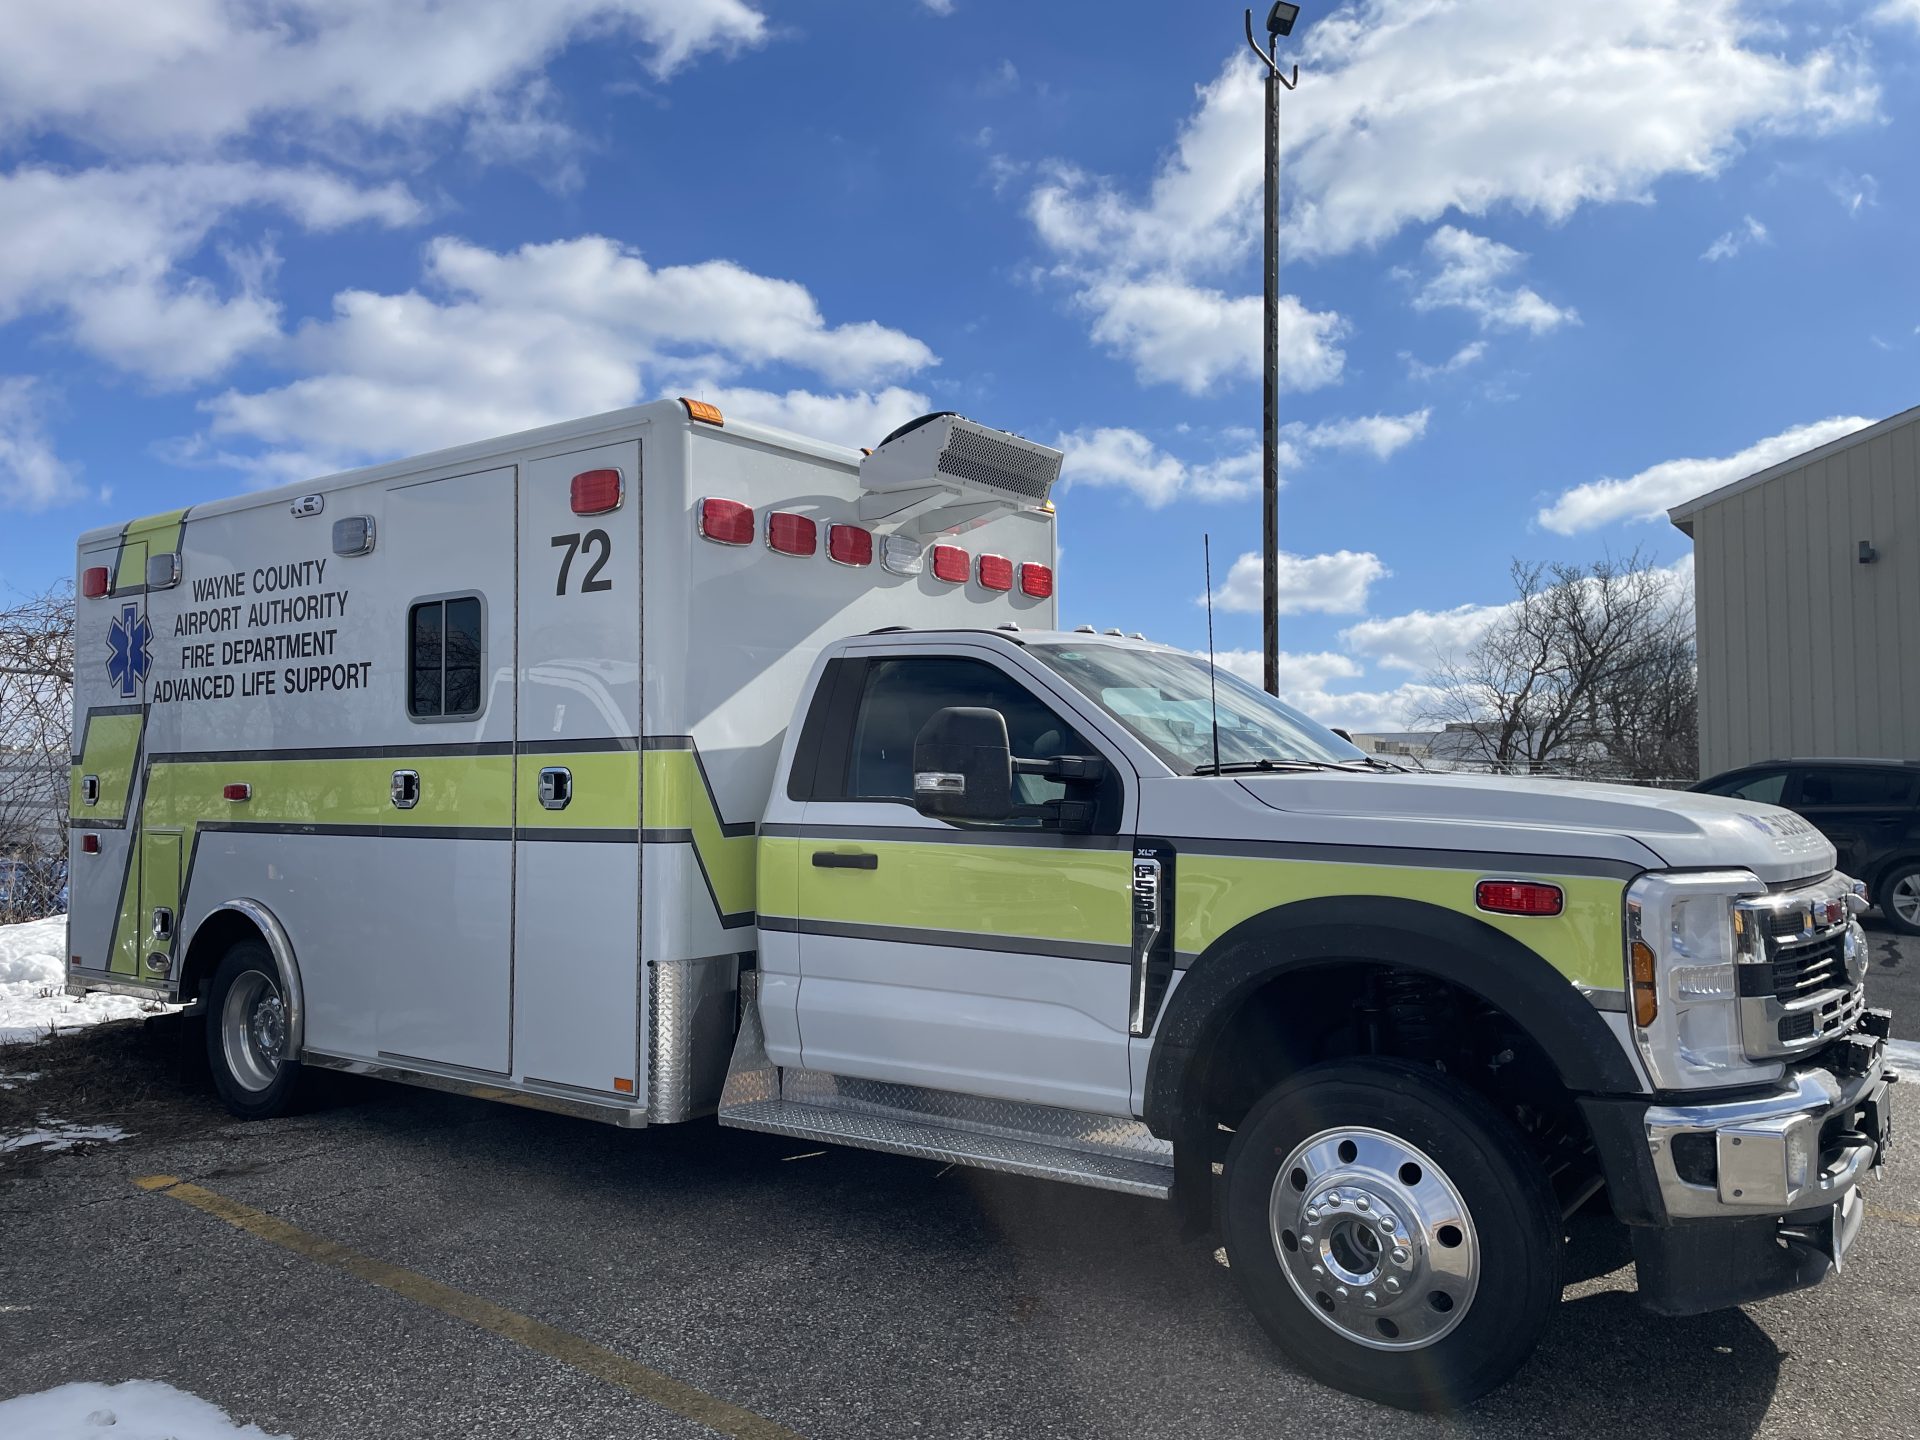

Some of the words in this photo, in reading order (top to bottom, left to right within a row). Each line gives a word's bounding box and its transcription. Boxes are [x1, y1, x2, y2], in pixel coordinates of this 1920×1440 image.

[192, 572, 246, 602] WAYNE
[252, 558, 327, 594] COUNTY
[551, 528, 612, 596] 72
[174, 605, 242, 637] AIRPORT
[247, 590, 349, 628] AUTHORITY
[182, 643, 215, 669] FIRE
[222, 629, 337, 665] DEPARTMENT
[153, 674, 235, 703] ADVANCED
[242, 670, 276, 697] LIFE
[284, 661, 372, 694] SUPPORT
[1137, 848, 1157, 856] XLT
